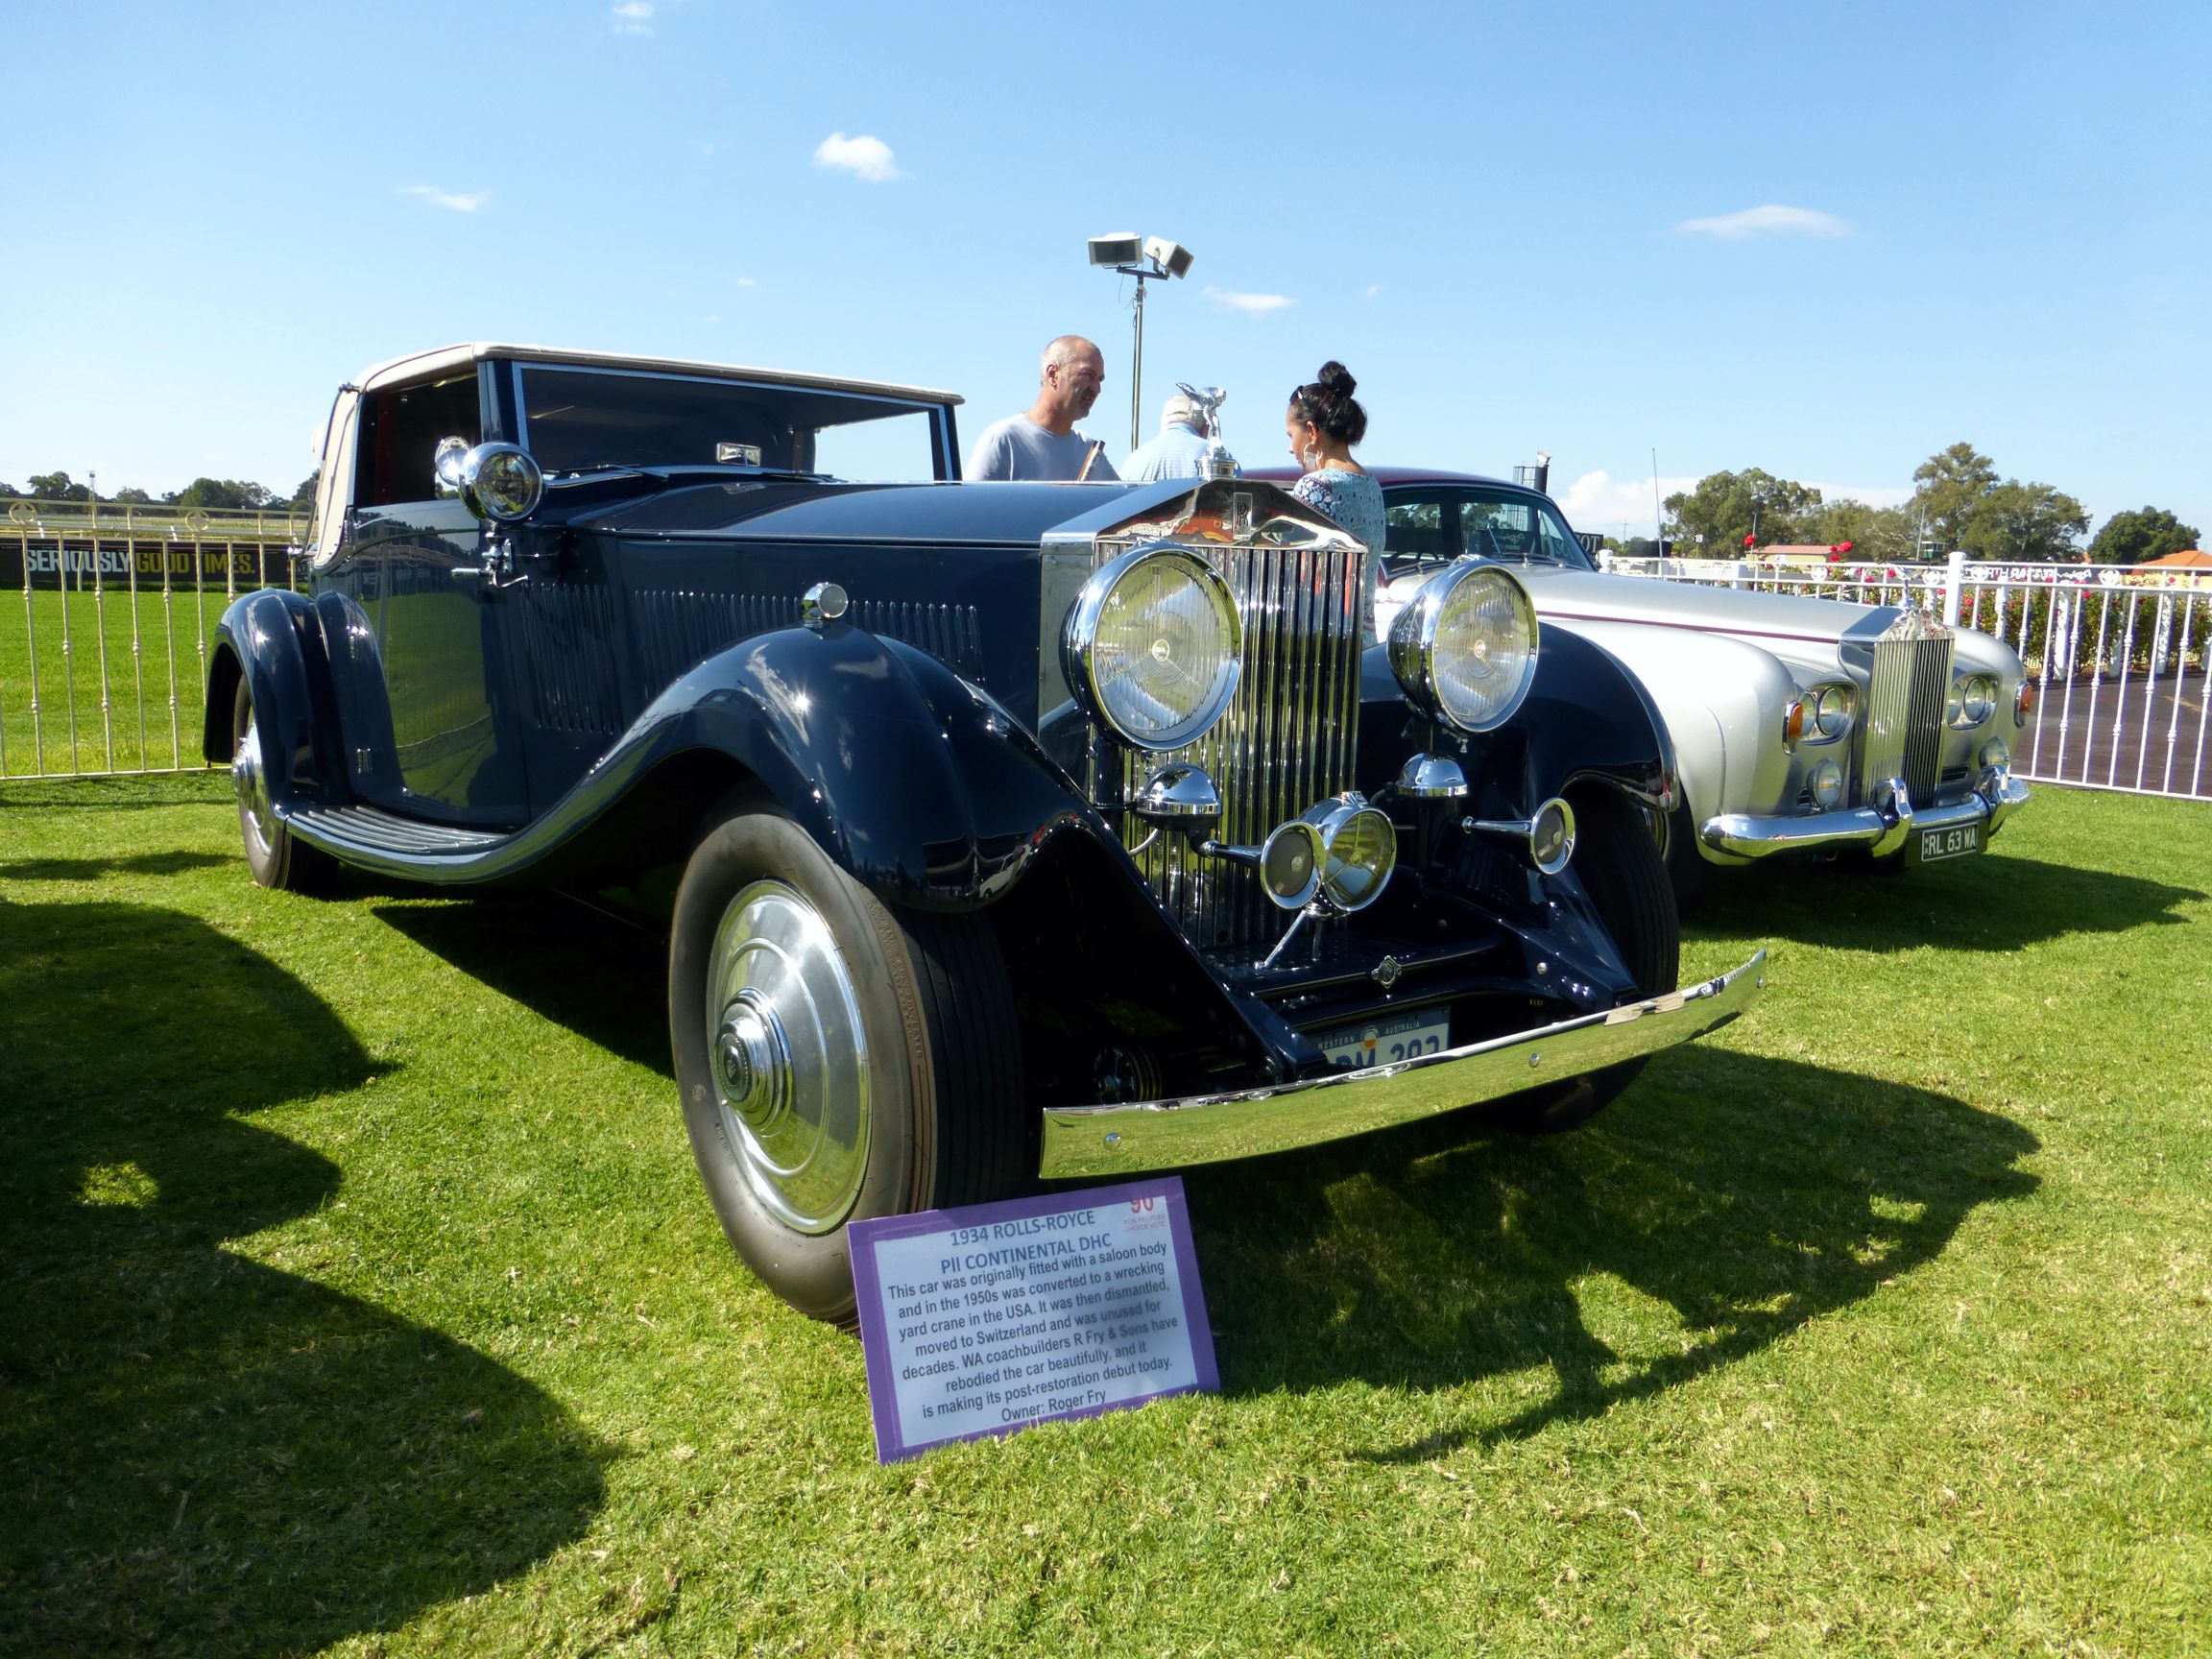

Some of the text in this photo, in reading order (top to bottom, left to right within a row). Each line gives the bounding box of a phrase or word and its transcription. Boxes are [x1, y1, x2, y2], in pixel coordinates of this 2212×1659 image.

[27, 549, 131, 573] SERIOUSLY
[136, 552, 189, 574] GOOD
[1929, 834, 1944, 855] RL
[1947, 830, 1961, 853] 63
[1964, 827, 1976, 849] WA
[1385, 1021, 1420, 1035] AUSTRALIA
[950, 1211, 1095, 1246] 1934 ROLLS-ROYCE
[965, 1238, 1076, 1270] CONTINENTAL
[1079, 1233, 1113, 1252] DHC
[888, 1241, 1166, 1300] This car was originally fitted with a saloon body
[898, 1262, 1165, 1318] and in the 1950s was converted to a wrecking
[899, 1278, 1170, 1342] yard crane in the USA. It was then dismantled,
[915, 1300, 1161, 1357] moved to Switzerland and was unused for
[902, 1316, 1178, 1380] decades. WA coachbuilders R Fry & Sons have
[946, 1341, 1146, 1392] rebodied the car beautifully, and it
[923, 1357, 1172, 1419] is making its post-restoration debut today.
[1001, 1389, 1106, 1422] Owner: Roger Fry
